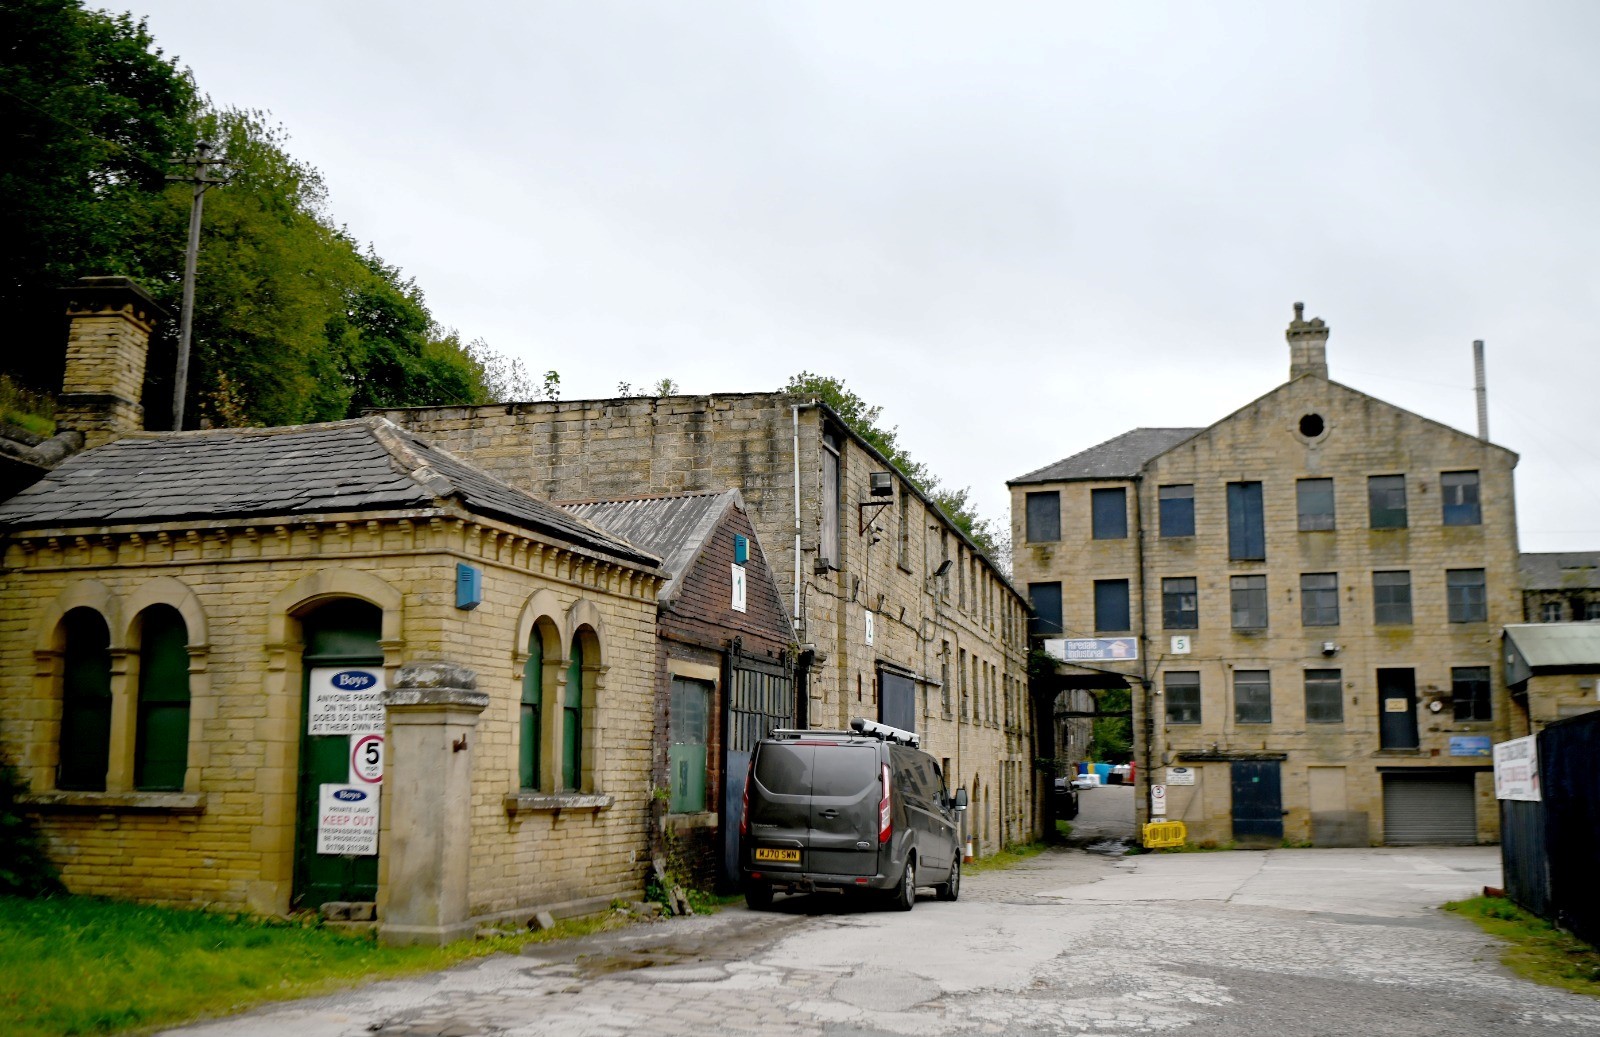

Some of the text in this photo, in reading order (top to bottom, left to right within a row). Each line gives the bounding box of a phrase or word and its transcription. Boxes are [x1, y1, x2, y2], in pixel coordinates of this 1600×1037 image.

[737, 576, 742, 602] 1
[868, 618, 872, 638] 2
[1177, 639, 1185, 650] 5
[339, 674, 369, 688] Boys
[316, 693, 383, 702] ANYONE PARKI
[324, 703, 382, 712] ON THIS LAND
[313, 713, 336, 722] DOES
[338, 713, 350, 722] SO
[312, 723, 385, 732] AT THEIR OWN RIS
[366, 742, 379, 765] 5
[339, 790, 362, 800] Boys
[322, 815, 375, 826] KEEP OUT
[333, 835, 373, 843] PROSECUTED
[759, 849, 797, 859] MJ70 SWN
